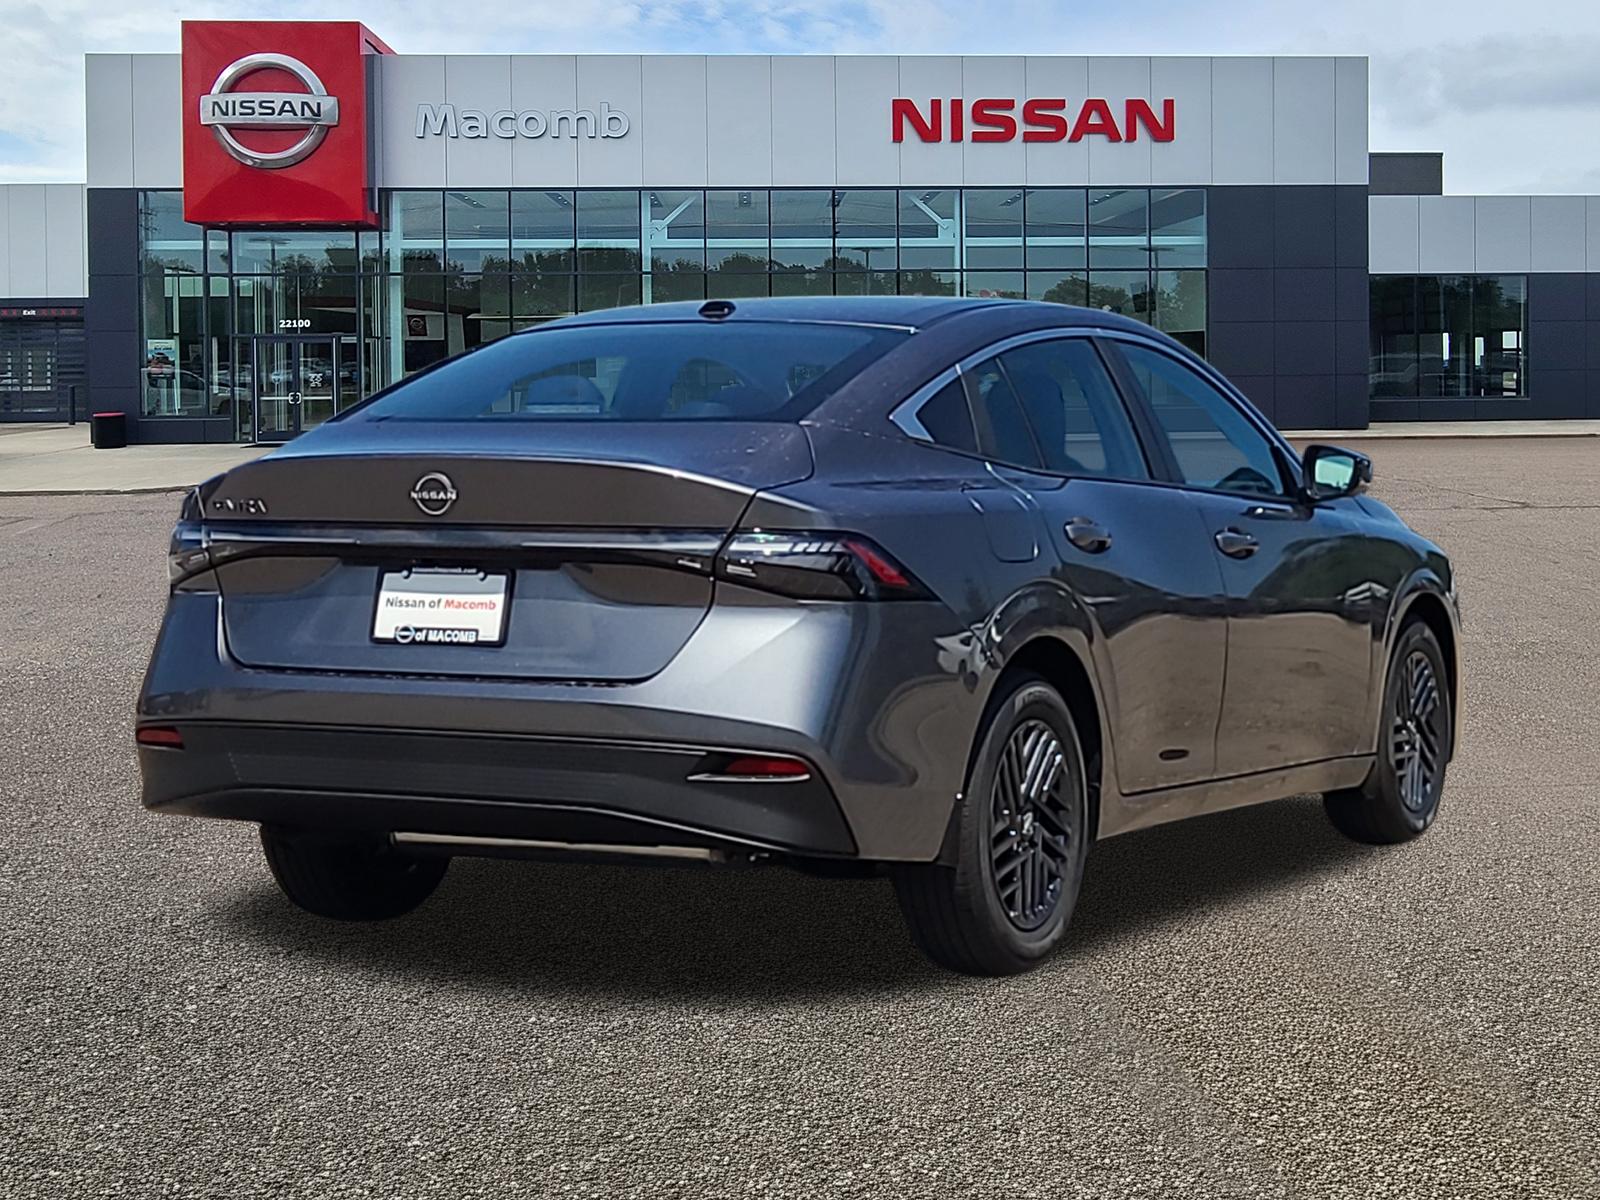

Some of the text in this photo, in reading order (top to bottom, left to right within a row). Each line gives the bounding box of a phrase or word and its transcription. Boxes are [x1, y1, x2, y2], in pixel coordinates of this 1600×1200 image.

[211, 99, 323, 118] NISSAN
[414, 102, 631, 139] Macomb
[891, 98, 1175, 143] NISSAN
[279, 319, 311, 328] 22100
[410, 489, 457, 500] NISSAN
[385, 596, 497, 611] Nissan of Macomb
[414, 629, 477, 643] of MACOMB
